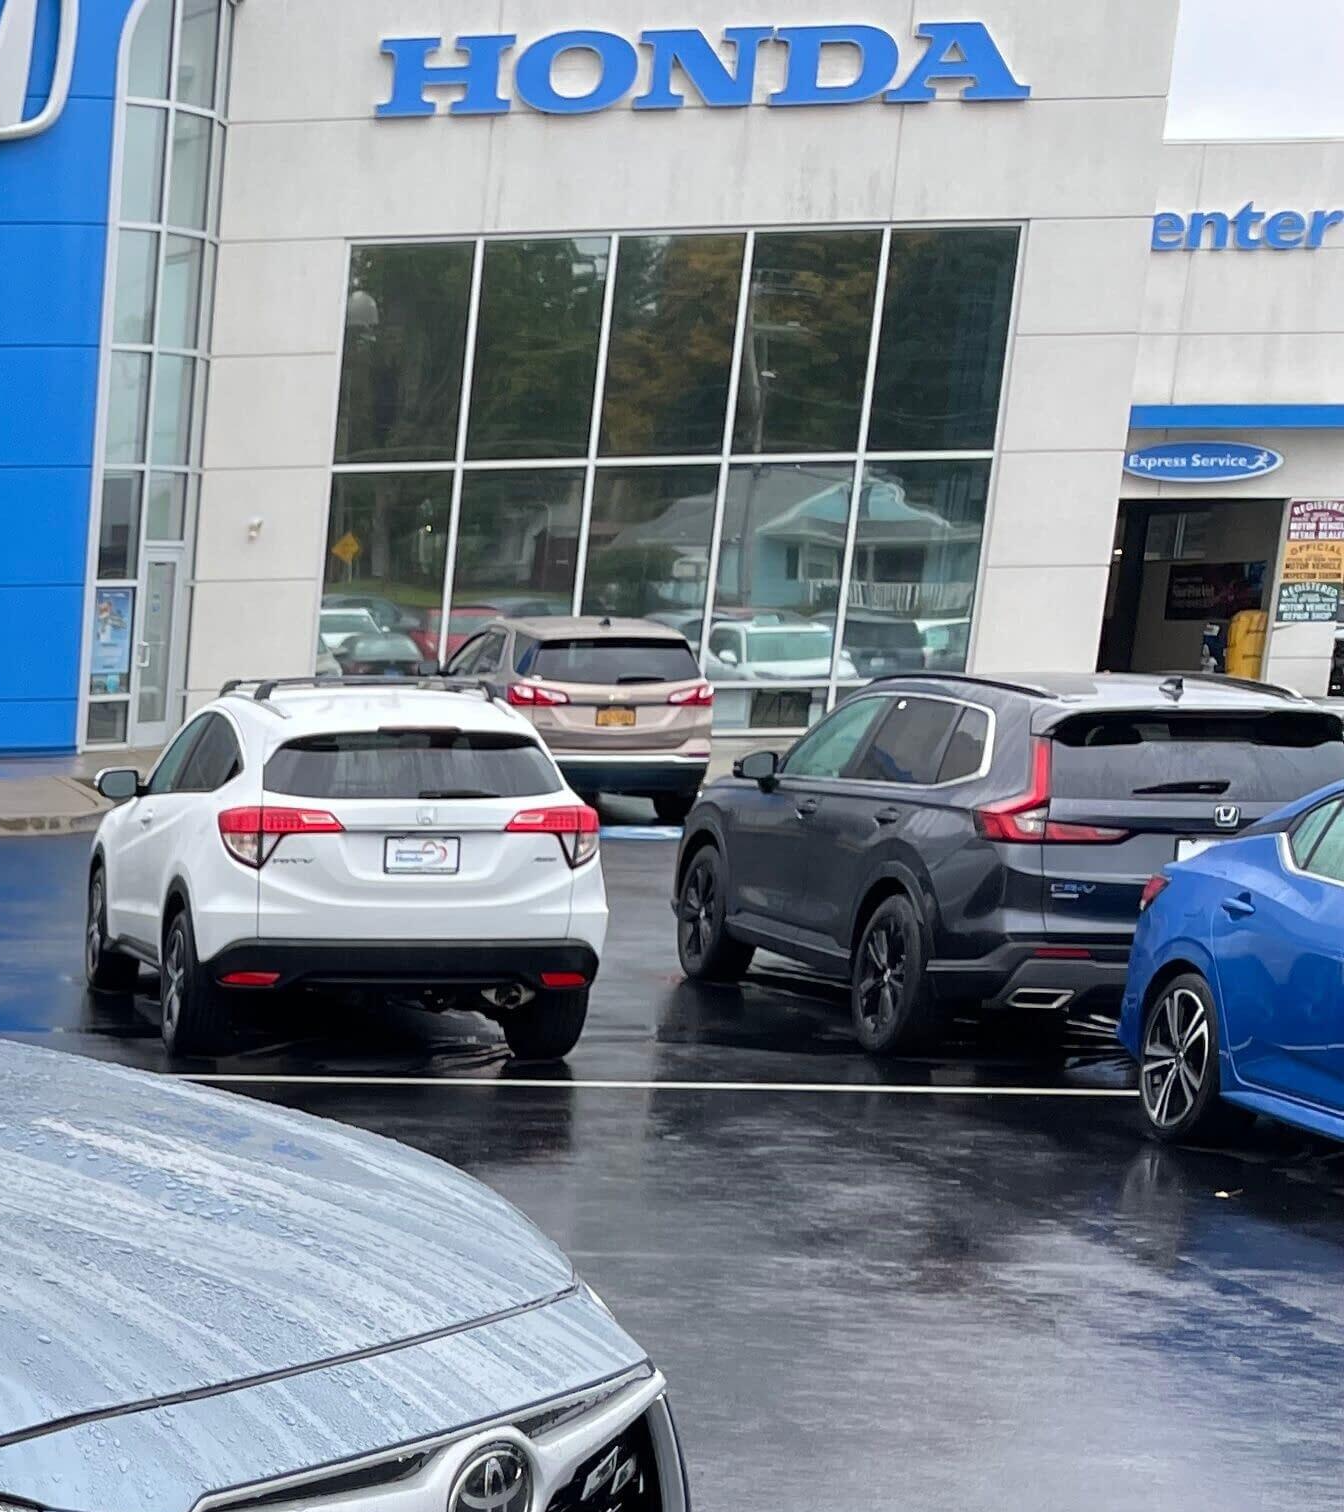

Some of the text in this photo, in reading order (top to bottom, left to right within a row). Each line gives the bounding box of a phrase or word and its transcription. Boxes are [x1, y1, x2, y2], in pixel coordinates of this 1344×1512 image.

[374, 21, 1032, 117] HONDA
[1150, 200, 1344, 251] enter
[1128, 452, 1248, 470] Express Service
[1290, 543, 1341, 556] OFFICIAL
[1281, 583, 1338, 598] REGISTERED
[1279, 603, 1337, 612] MOTOR VEHICLE
